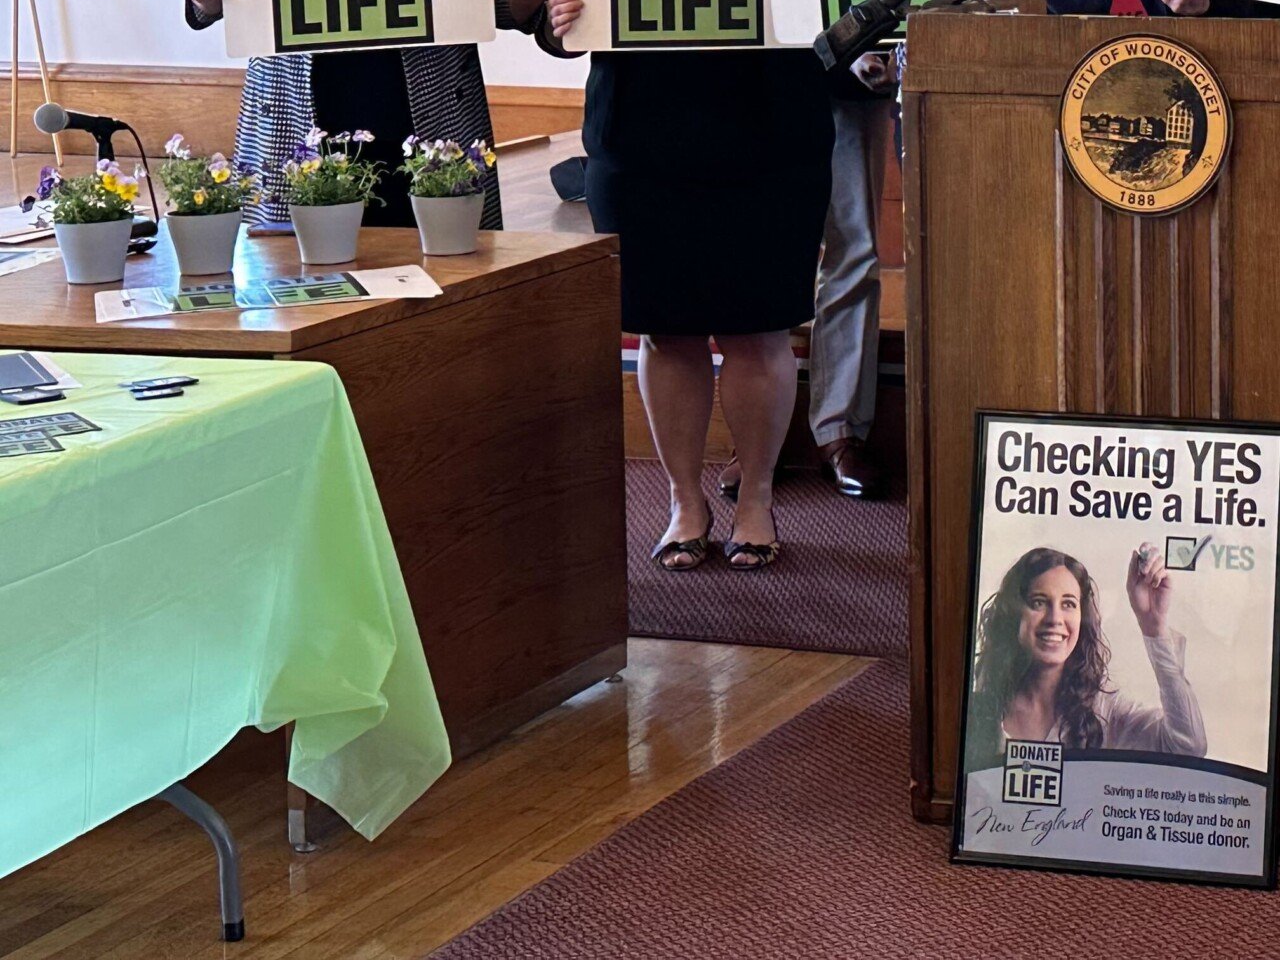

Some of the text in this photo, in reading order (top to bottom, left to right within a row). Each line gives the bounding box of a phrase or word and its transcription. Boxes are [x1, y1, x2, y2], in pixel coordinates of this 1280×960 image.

[1073, 43, 1221, 117] CITY OF WOONSOCKET
[1120, 191, 1155, 206] 1888
[998, 430, 1262, 489] Checking YES
[994, 476, 1266, 527] Can Save a Life.
[1210, 543, 1255, 571] YES
[1010, 745, 1059, 761] DONATE
[1008, 773, 1057, 799] LIFE
[1103, 784, 1251, 808] Saving a life really is this simple.
[971, 806, 1093, 846] New England
[1102, 805, 1250, 829] Check YES today and be an
[1102, 821, 1250, 848] Organ & Tissue donor.
